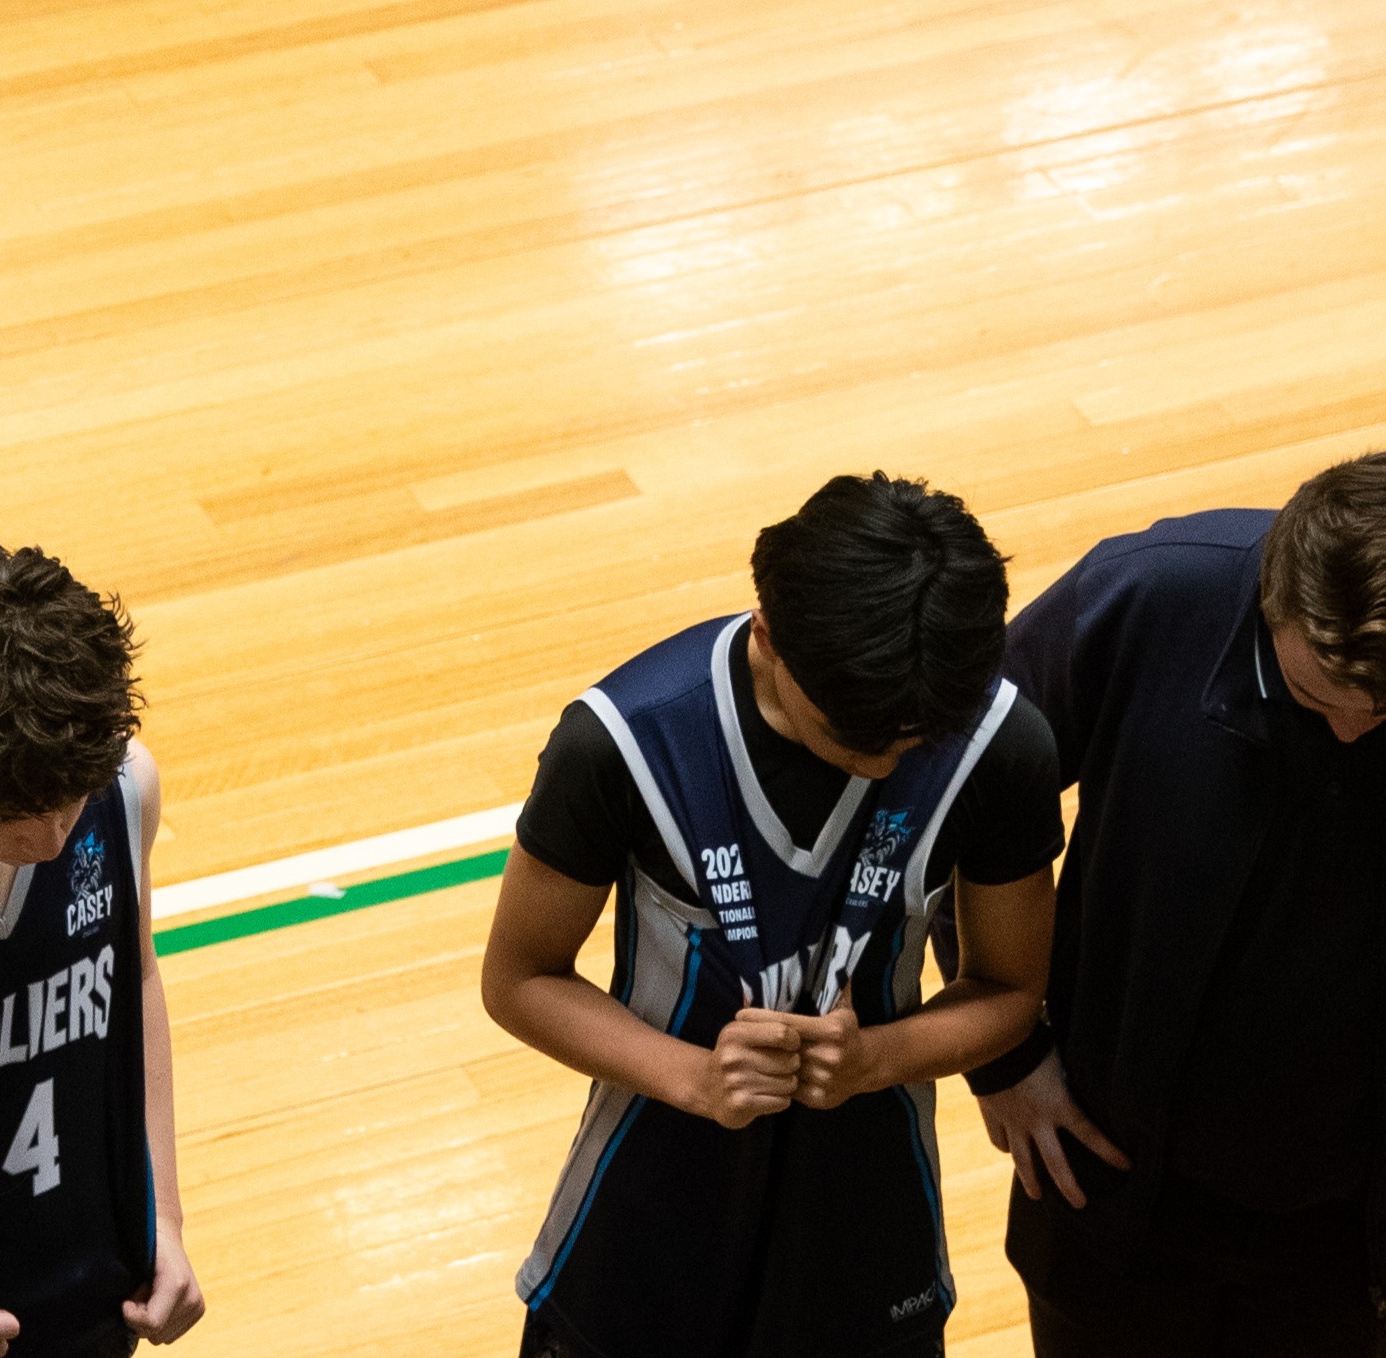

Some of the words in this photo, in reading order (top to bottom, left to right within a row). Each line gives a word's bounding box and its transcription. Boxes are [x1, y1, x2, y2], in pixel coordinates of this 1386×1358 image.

[701, 843, 745, 880] 202
[66, 884, 114, 937] CASEY
[711, 880, 753, 905] NDER
